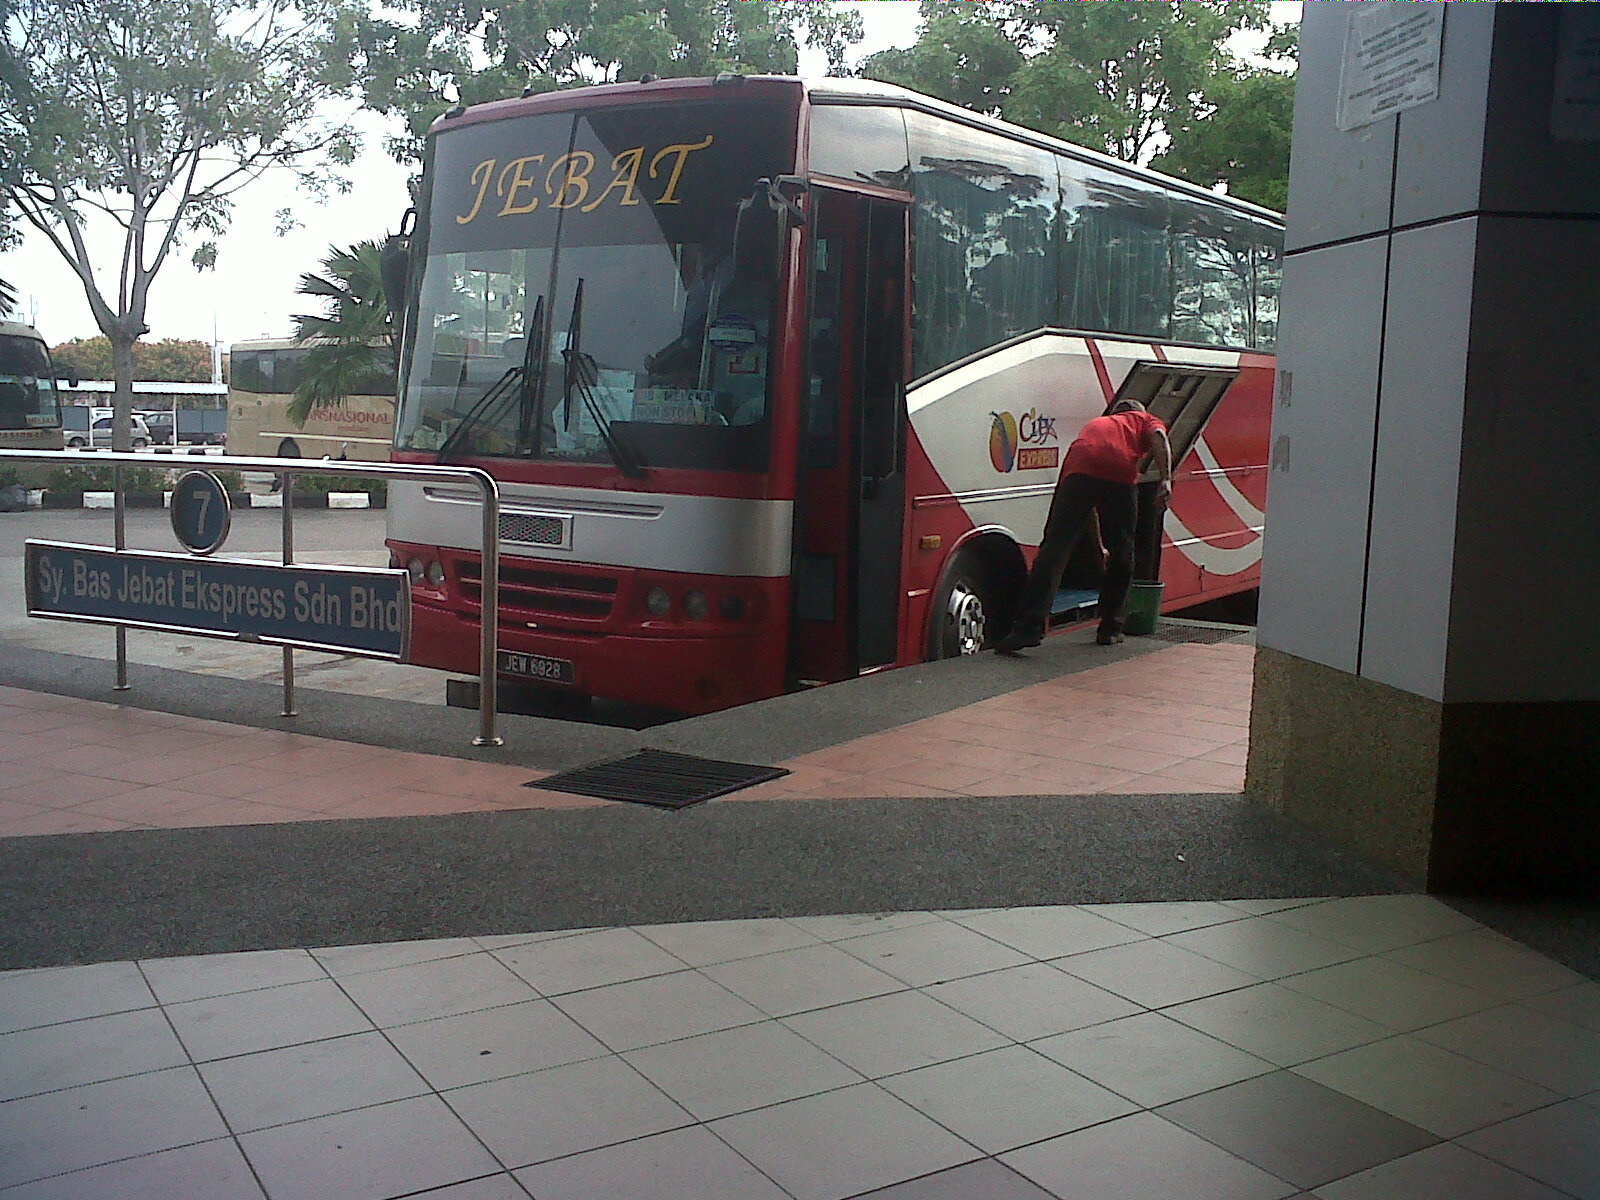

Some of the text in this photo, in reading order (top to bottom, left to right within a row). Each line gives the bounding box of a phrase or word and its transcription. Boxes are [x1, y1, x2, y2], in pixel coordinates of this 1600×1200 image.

[456, 135, 714, 225] JEBAT
[193, 490, 211, 534] 7
[39, 555, 402, 633] Sy. Bas Jebat Ekspress Sdn Bhd
[505, 654, 528, 673] JEW
